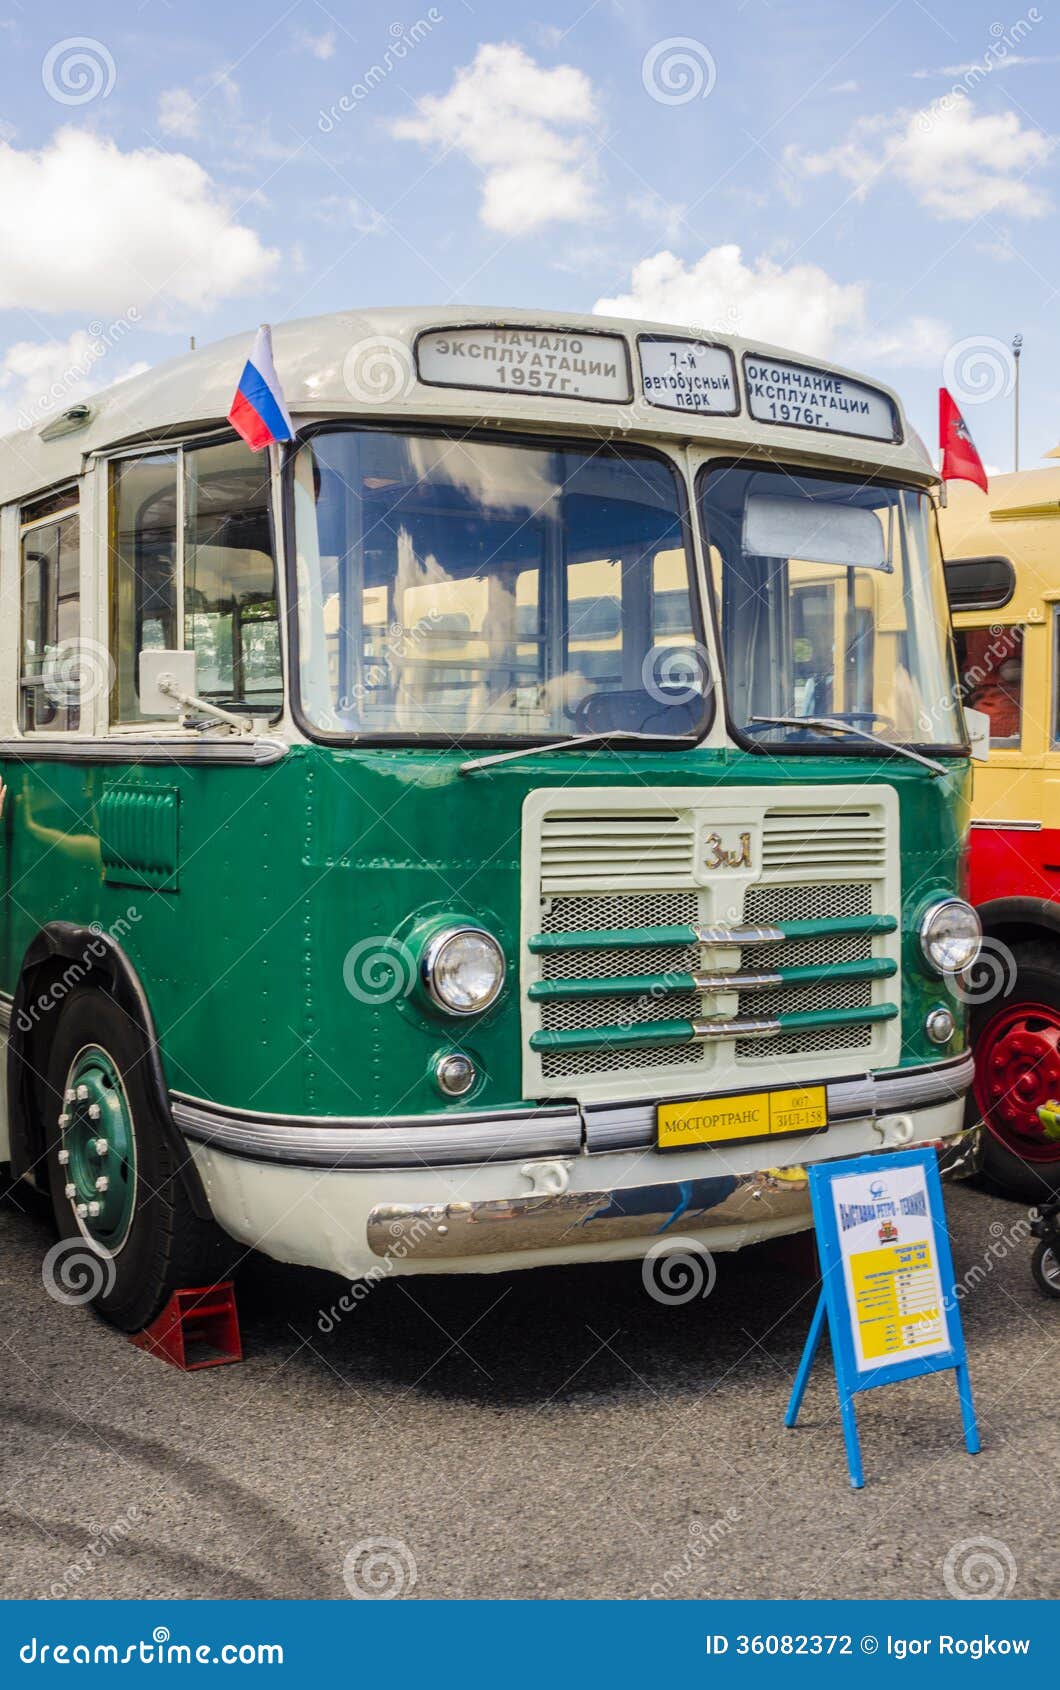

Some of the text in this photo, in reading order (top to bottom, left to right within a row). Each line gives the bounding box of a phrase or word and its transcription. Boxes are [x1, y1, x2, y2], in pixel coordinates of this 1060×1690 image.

[493, 330, 583, 354] НАЧАЛО
[435, 339, 617, 378] ЭКСПЛУАТАЦИИ
[669, 352, 697, 369] 7-й
[496, 366, 580, 393] 1957г.
[644, 372, 731, 393] автобусный
[747, 366, 844, 395] ОКОНЧАНИЕ
[676, 391, 711, 411] парк
[769, 402, 830, 427] 1976г.
[664, 1109, 760, 1133] МОСГОРТРАНС
[777, 1110, 822, 1127] ЗИЛ-158
[876, 1201, 896, 1218] РЕТРО
